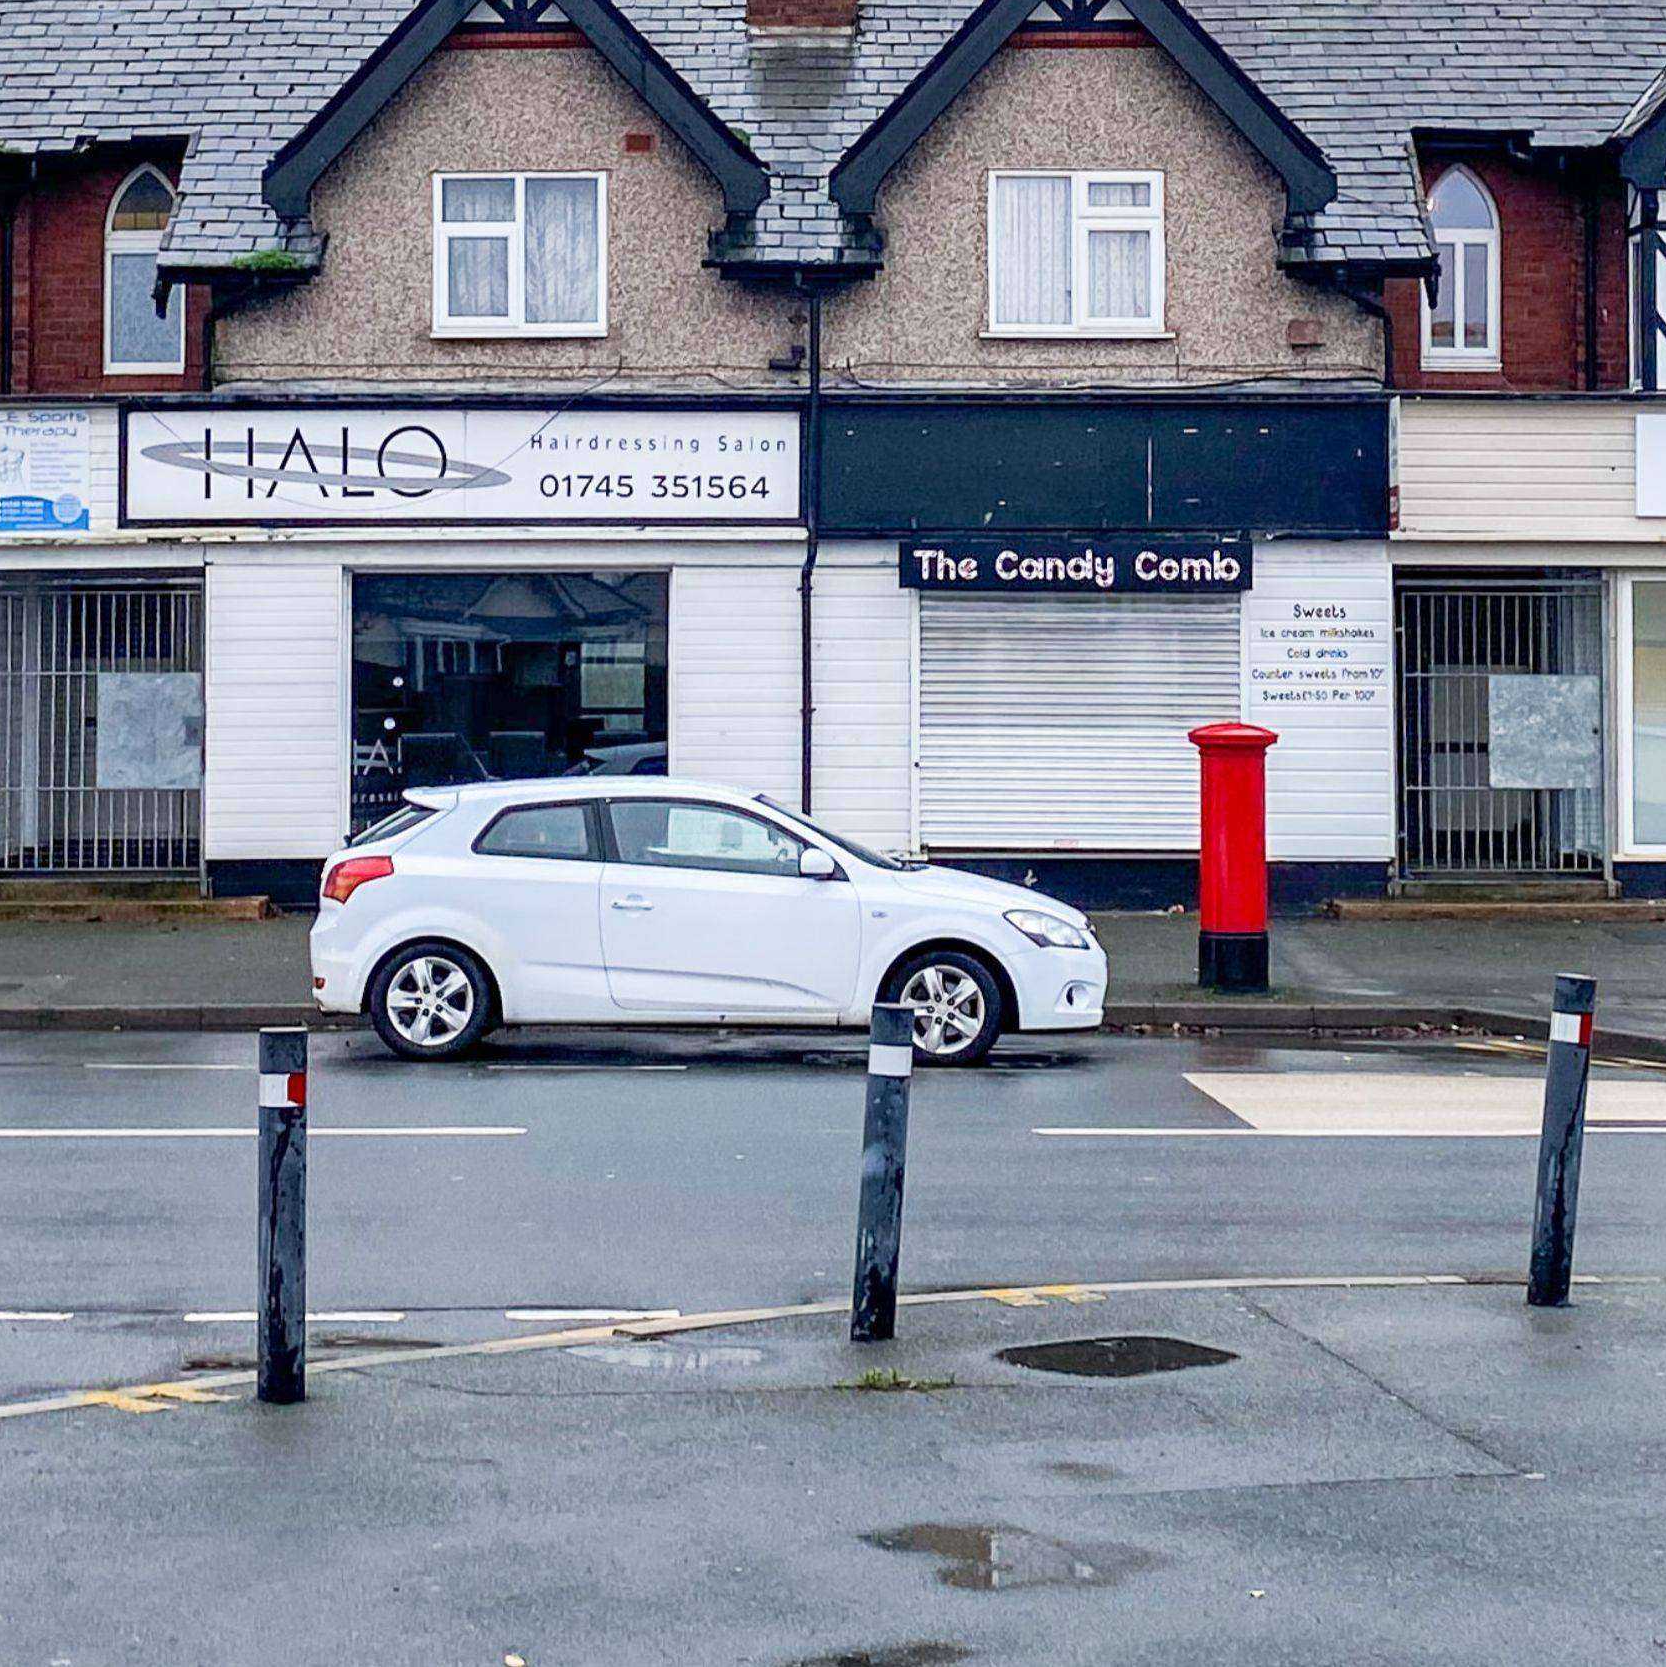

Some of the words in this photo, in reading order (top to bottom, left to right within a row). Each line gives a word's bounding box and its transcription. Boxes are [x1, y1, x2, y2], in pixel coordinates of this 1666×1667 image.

[530, 434, 700, 453] Hairdressing
[718, 434, 786, 452] Salon
[205, 425, 447, 499] HALO
[539, 474, 634, 498] 01745
[651, 475, 770, 499] 351564
[913, 549, 978, 581] The
[995, 549, 1115, 588] Candy
[1136, 550, 1241, 581] Comb
[1292, 603, 1347, 619] Sweets
[1260, 628, 1276, 638] Ice
[1282, 630, 1315, 638] cream
[1319, 627, 1375, 638] milkshakes
[1287, 647, 1311, 659] Cold
[1315, 648, 1349, 659] drinks
[1299, 669, 1337, 680] sweets
